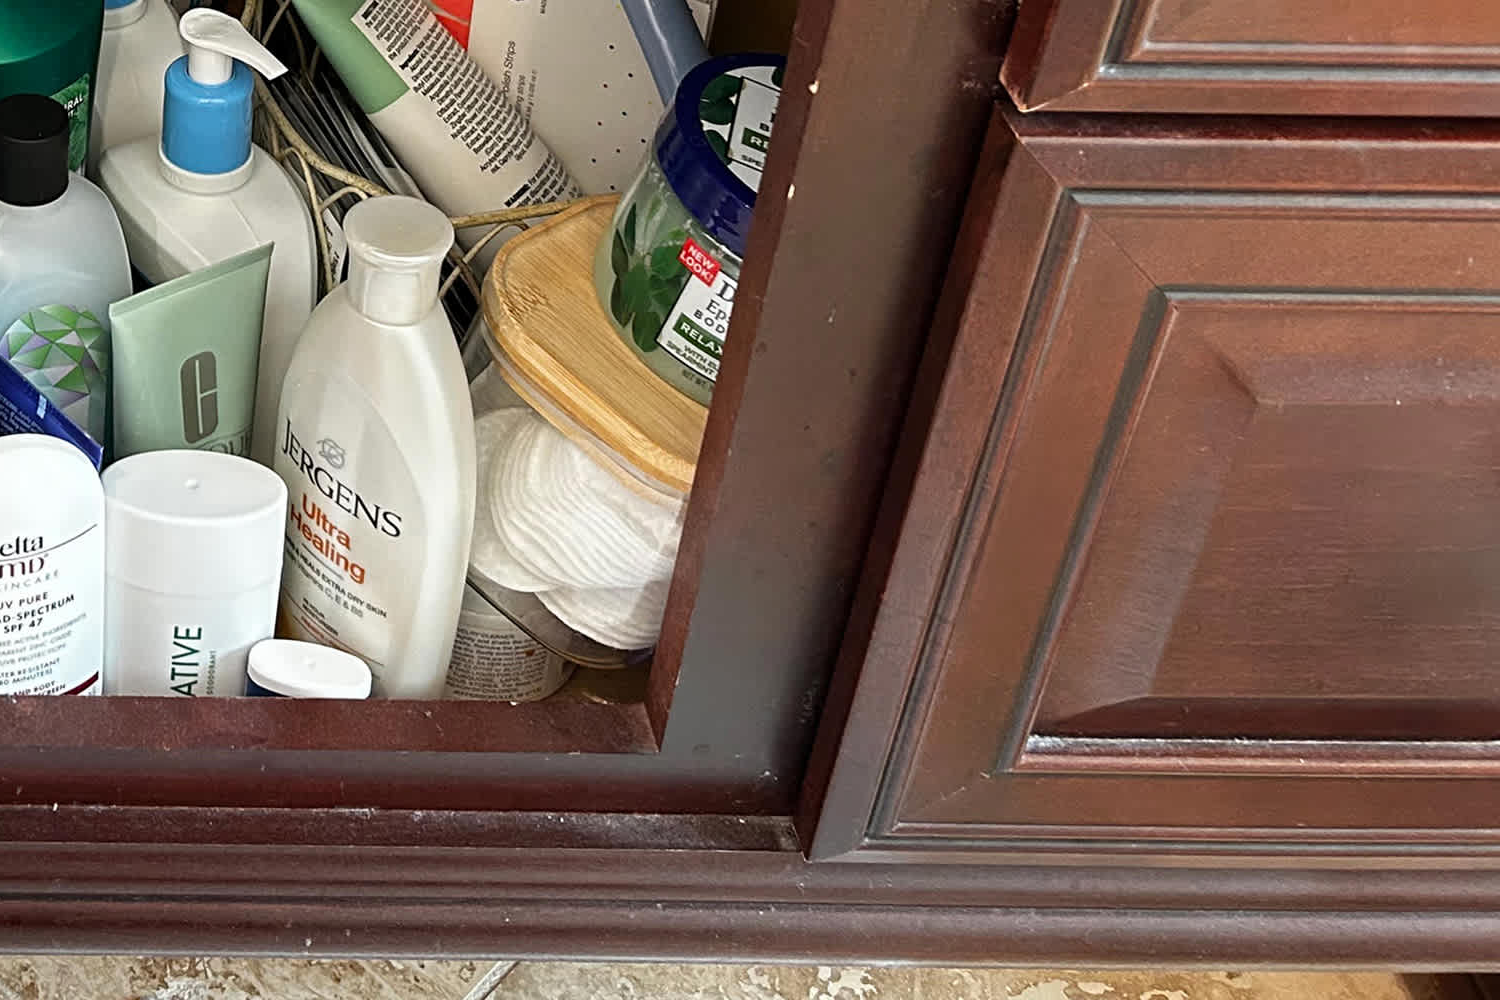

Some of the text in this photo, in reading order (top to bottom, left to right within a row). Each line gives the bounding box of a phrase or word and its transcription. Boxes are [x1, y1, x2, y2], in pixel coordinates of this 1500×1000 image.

[504, 40, 516, 70] Strips
[680, 250, 714, 283] LOOK!
[688, 245, 714, 270] NEW
[694, 309, 726, 334] BOD
[282, 418, 402, 537] JERGENS
[303, 493, 351, 550] Ultra
[0, 536, 43, 557] elta
[290, 503, 365, 584] Healing
[19, 592, 48, 607] PURE
[4, 618, 43, 634] SPF 47
[18, 658, 60, 675] RESISTANT
[170, 626, 202, 697] ATIVE
[34, 681, 55, 692] BODY
